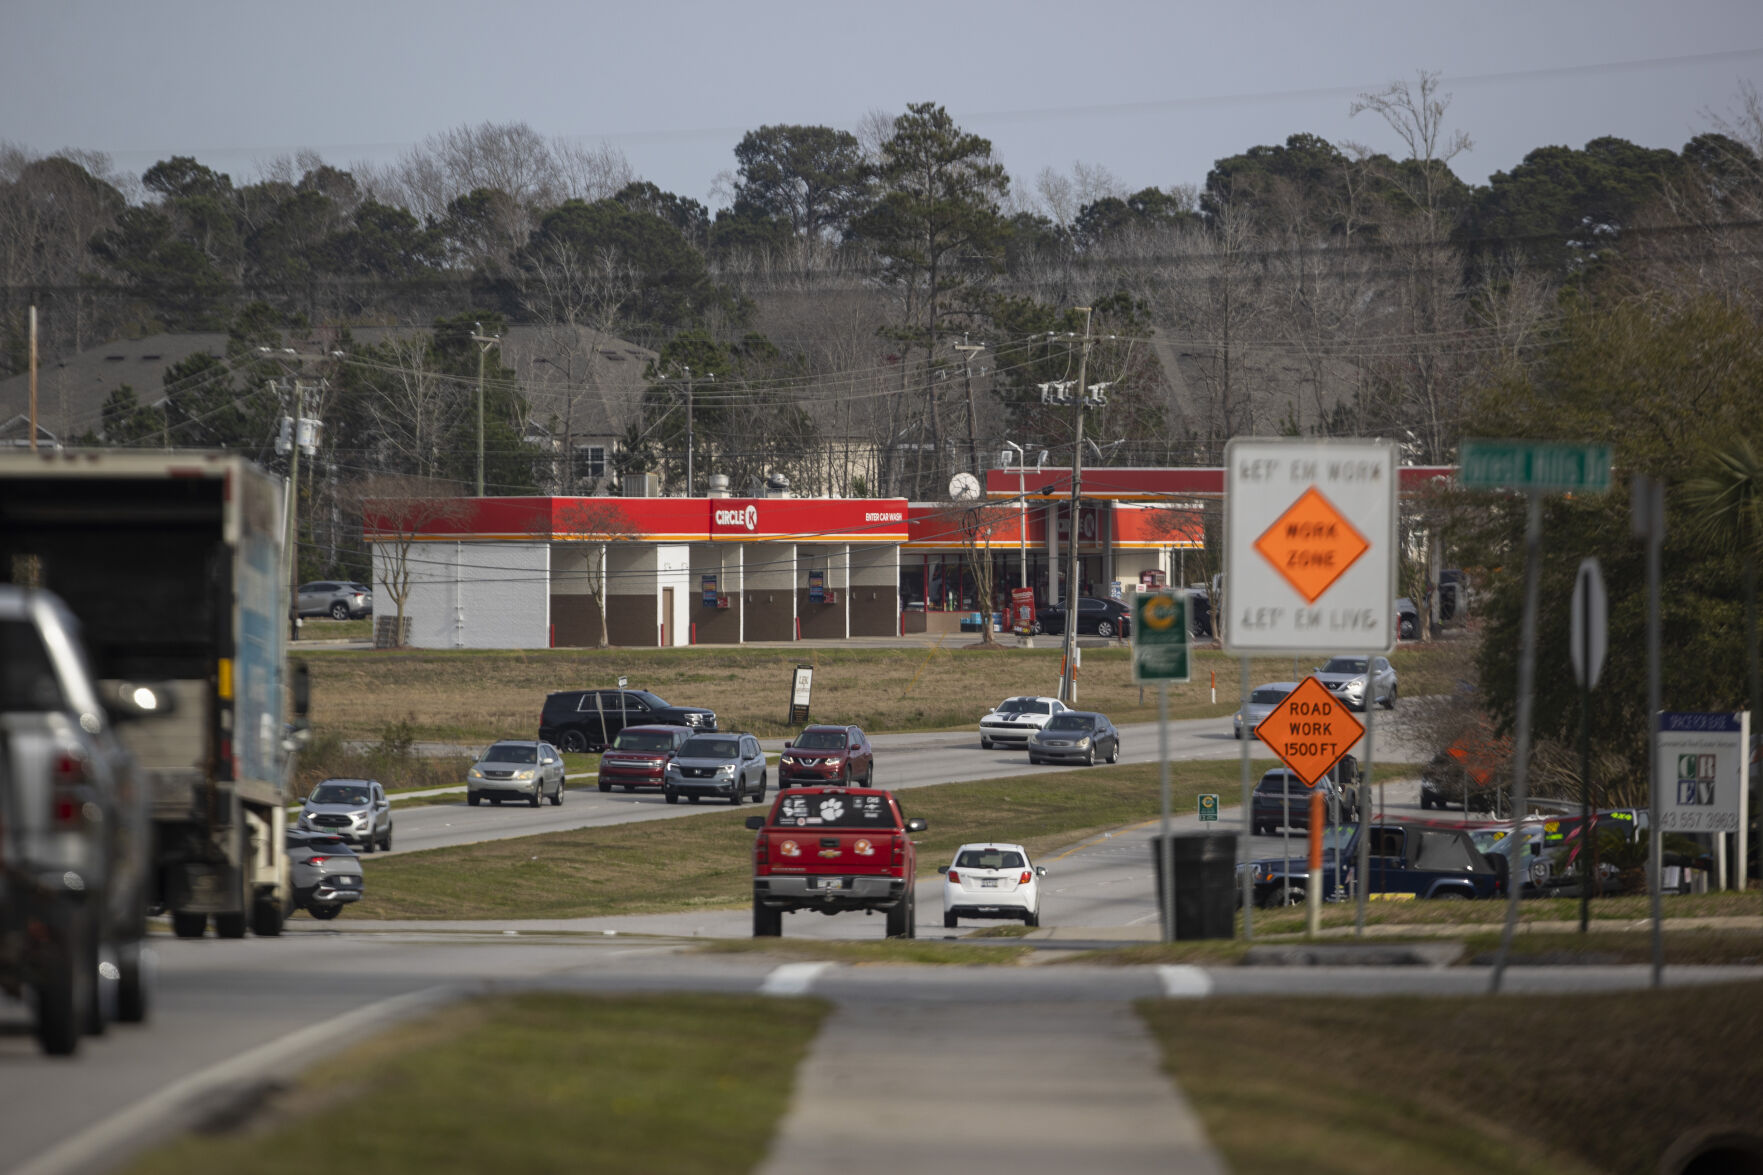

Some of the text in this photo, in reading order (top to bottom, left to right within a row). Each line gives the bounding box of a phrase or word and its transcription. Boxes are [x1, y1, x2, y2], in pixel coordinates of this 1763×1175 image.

[1327, 459, 1384, 482] WORK
[716, 505, 757, 530] CIRCLE K
[865, 512, 902, 521] ENTER CAR WASH
[1286, 522, 1338, 539] WORK
[1286, 550, 1336, 567] ZONE
[1328, 608, 1378, 631] LIVE
[1290, 702, 1332, 716] ROAD
[1290, 722, 1332, 736] WORK
[1284, 743, 1337, 756] 1500 FT
